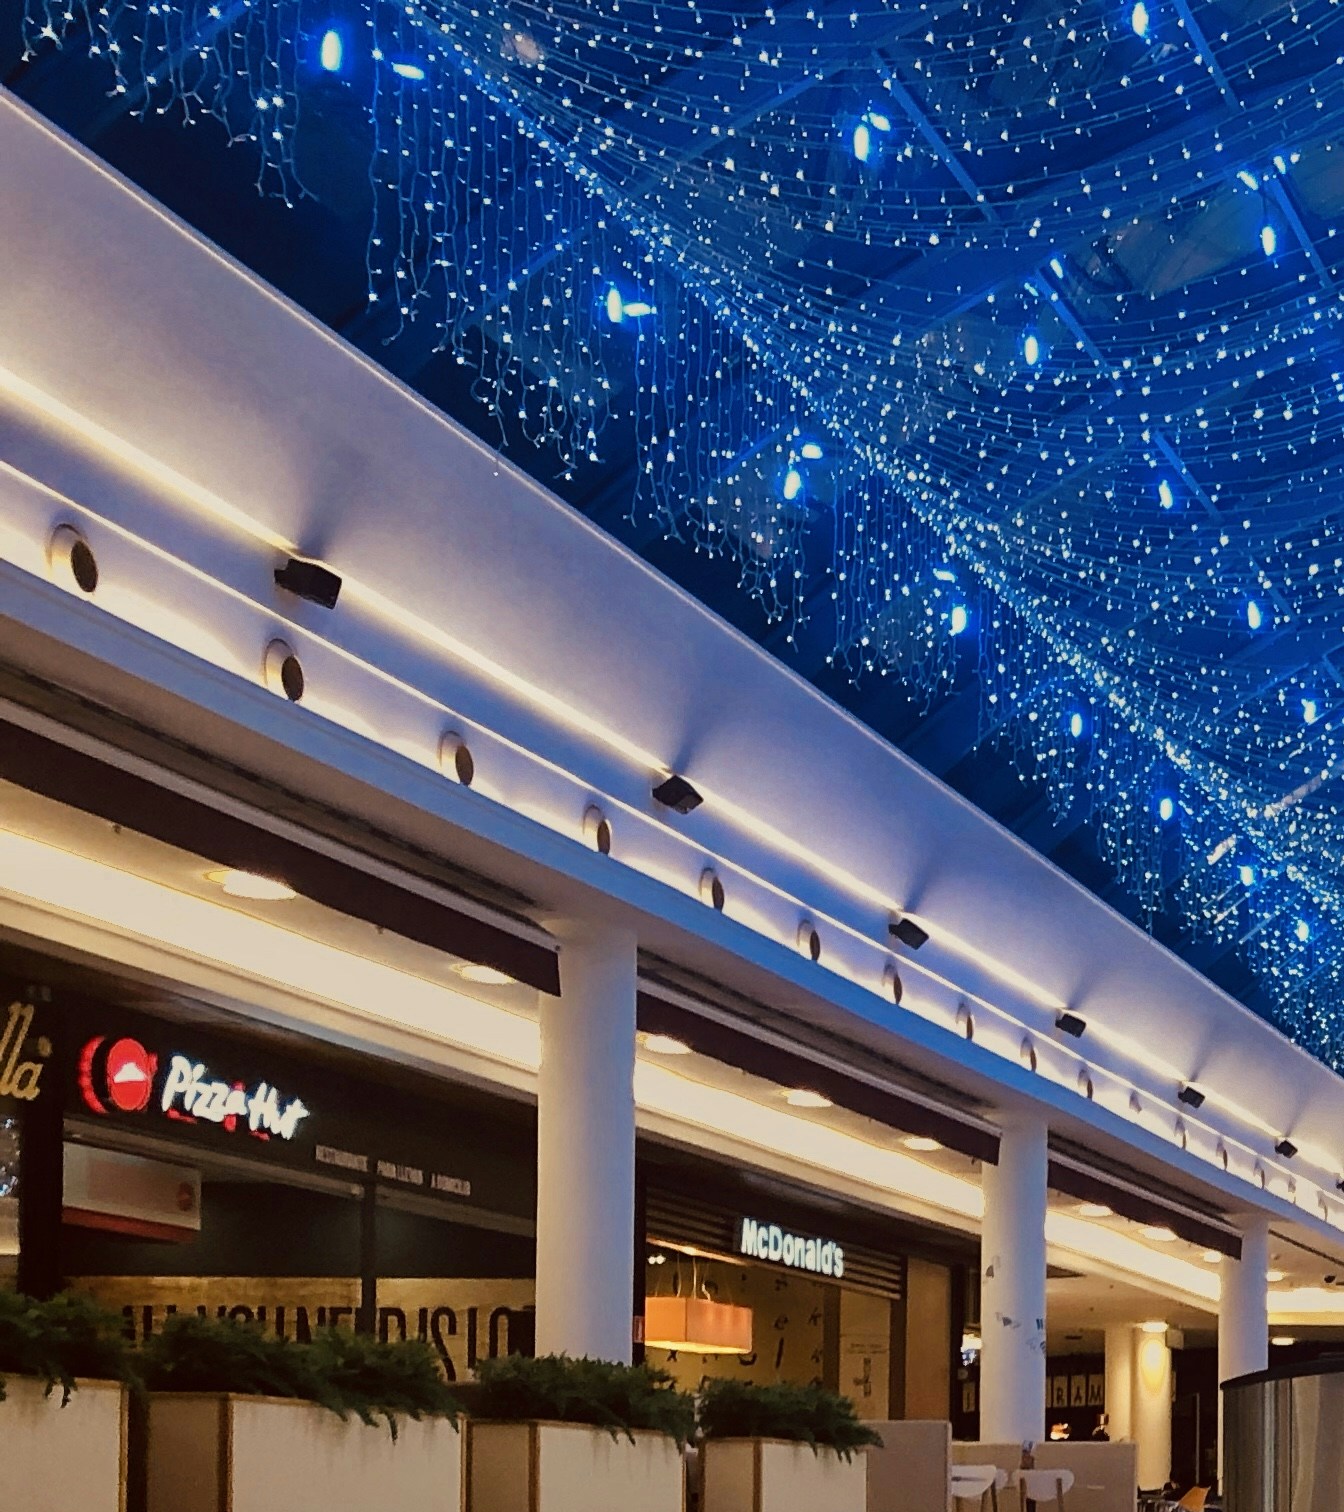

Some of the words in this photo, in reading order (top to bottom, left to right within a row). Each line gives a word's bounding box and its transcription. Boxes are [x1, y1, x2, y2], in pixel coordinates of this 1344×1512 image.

[162, 1055, 249, 1123] Pizza
[248, 1082, 310, 1140] Hut
[741, 1217, 844, 1278] McDonald's
